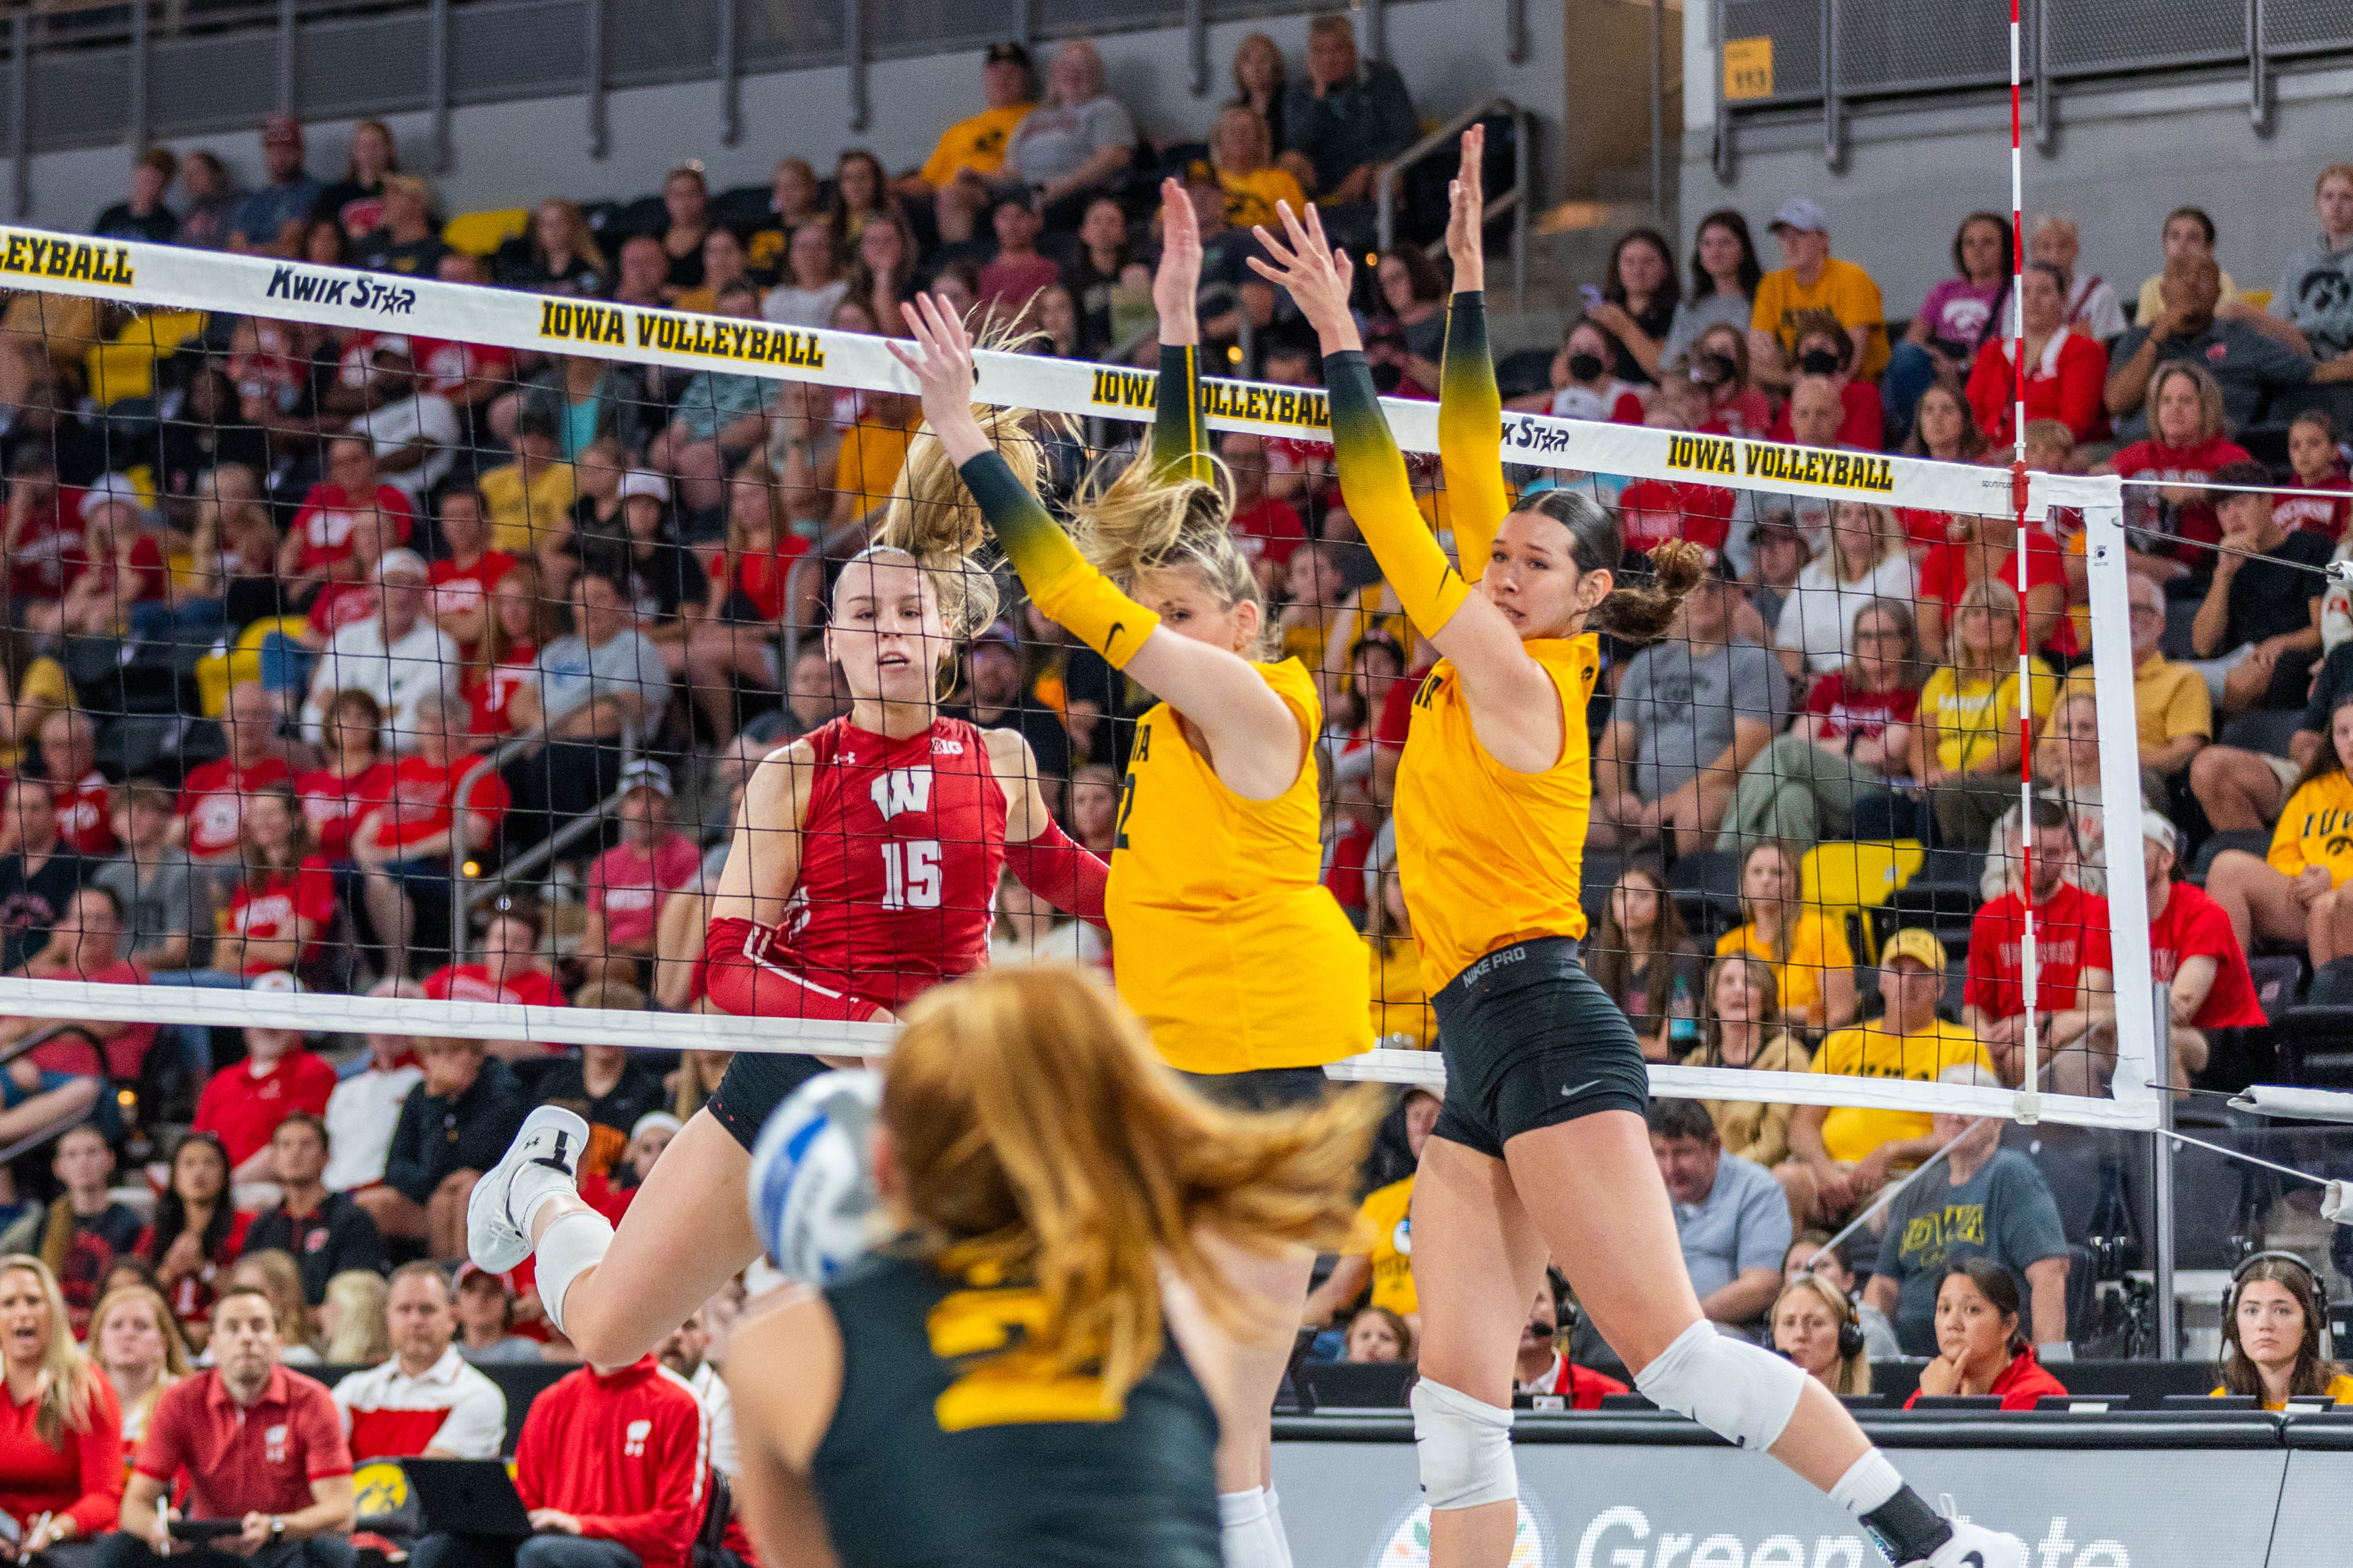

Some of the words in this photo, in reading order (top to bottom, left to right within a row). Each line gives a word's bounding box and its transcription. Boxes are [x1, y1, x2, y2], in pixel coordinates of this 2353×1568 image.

[0, 232, 134, 288] EYBALL
[540, 298, 625, 346] IOWA
[635, 312, 824, 370] VOLLEYBALL
[1201, 380, 1331, 429] OLLEYBAL
[1667, 434, 1735, 475] IOWA
[1745, 443, 1893, 493] VOLLEYBALL
[881, 840, 943, 911] 15
[1462, 958, 1490, 989] NIKE
[1492, 947, 1526, 969] PRO
